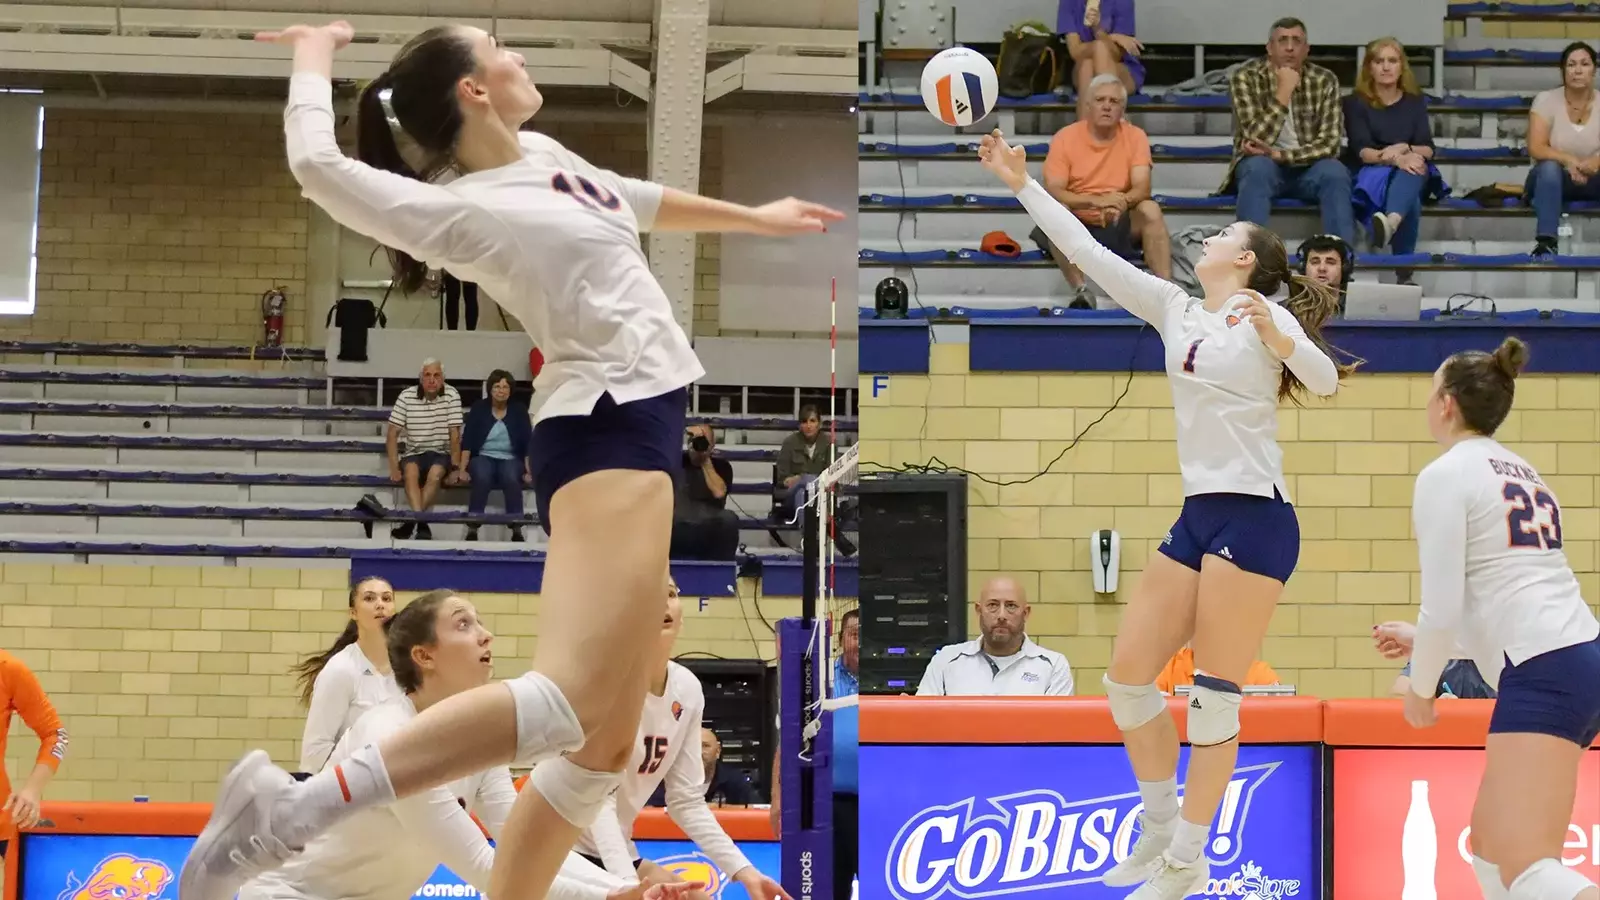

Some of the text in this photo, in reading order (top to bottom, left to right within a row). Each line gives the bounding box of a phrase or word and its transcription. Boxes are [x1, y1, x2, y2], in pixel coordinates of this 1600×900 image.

[1183, 338, 1206, 373] 1
[872, 375, 889, 398] F
[1502, 481, 1563, 550] 23
[698, 597, 710, 612] F
[637, 735, 668, 775] 15
[416, 883, 477, 897] omen
[799, 851, 813, 894] sports
